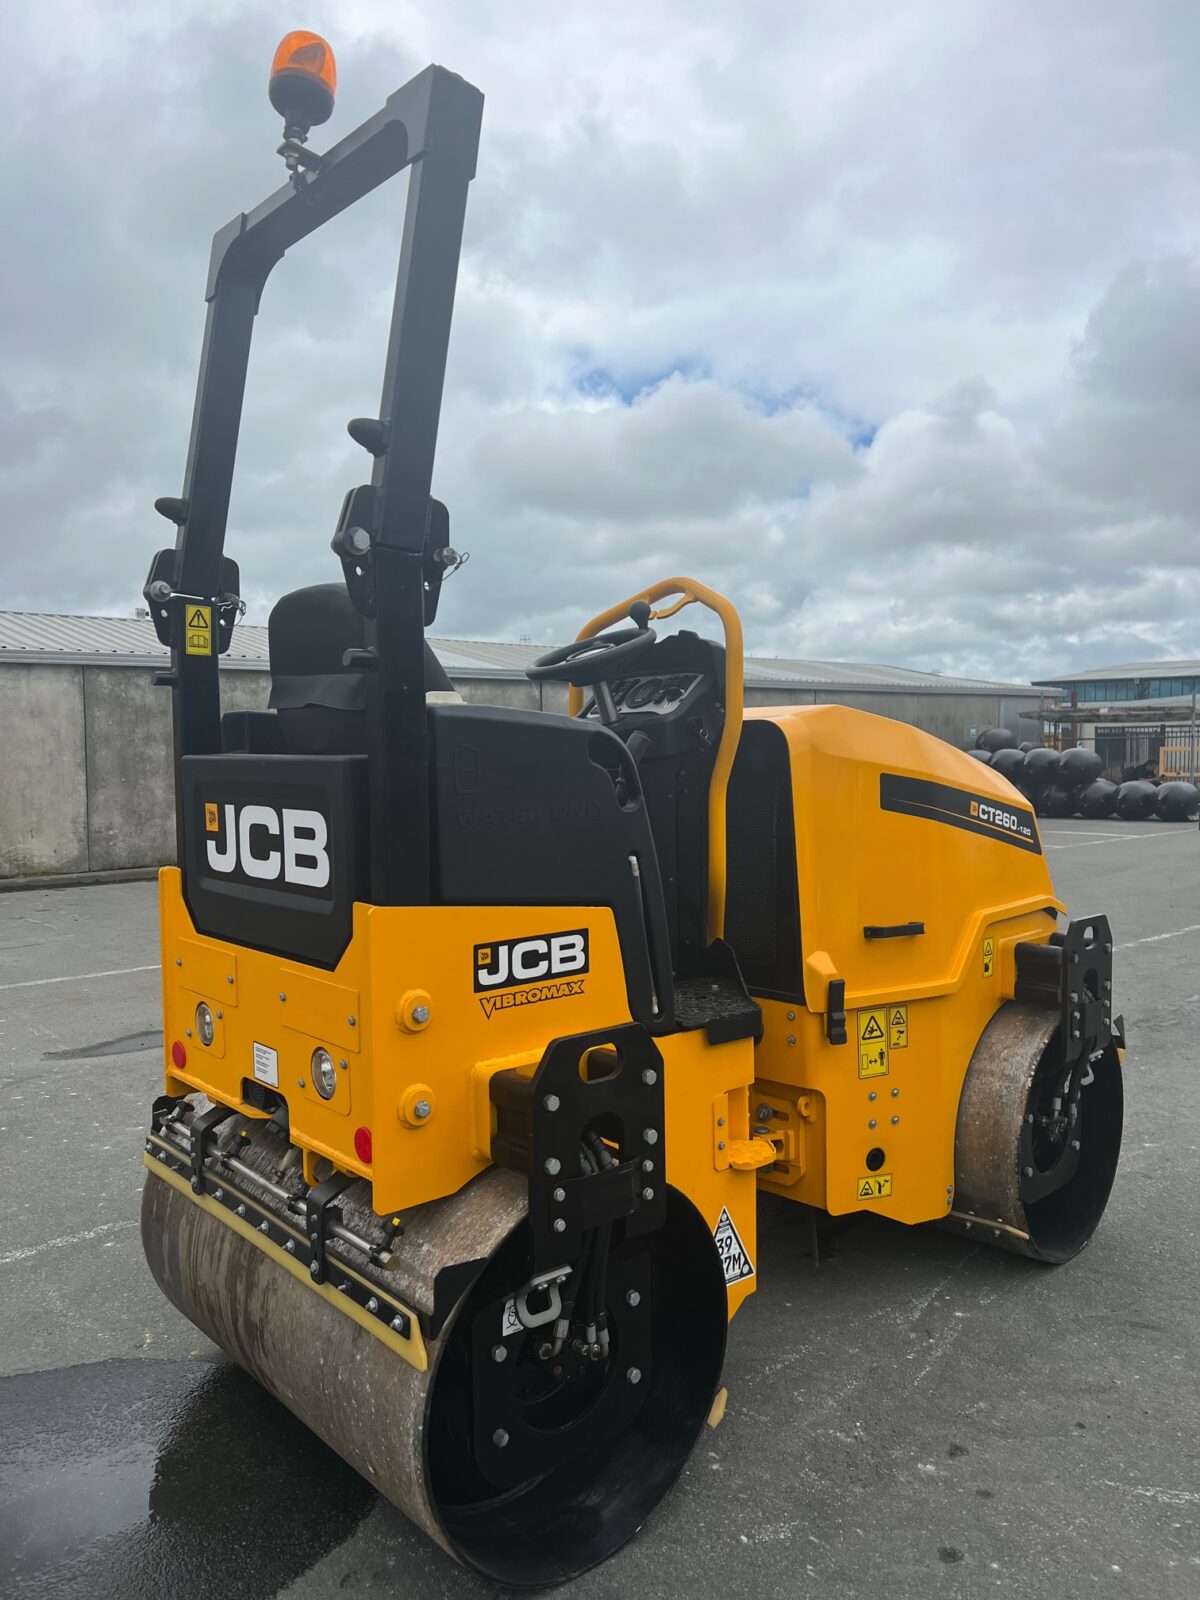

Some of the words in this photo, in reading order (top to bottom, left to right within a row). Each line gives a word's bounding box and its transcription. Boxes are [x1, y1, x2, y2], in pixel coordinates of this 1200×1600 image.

[205, 803, 330, 888] JCB
[478, 934, 586, 986] JCB
[479, 979, 585, 1020] VIBROMAX
